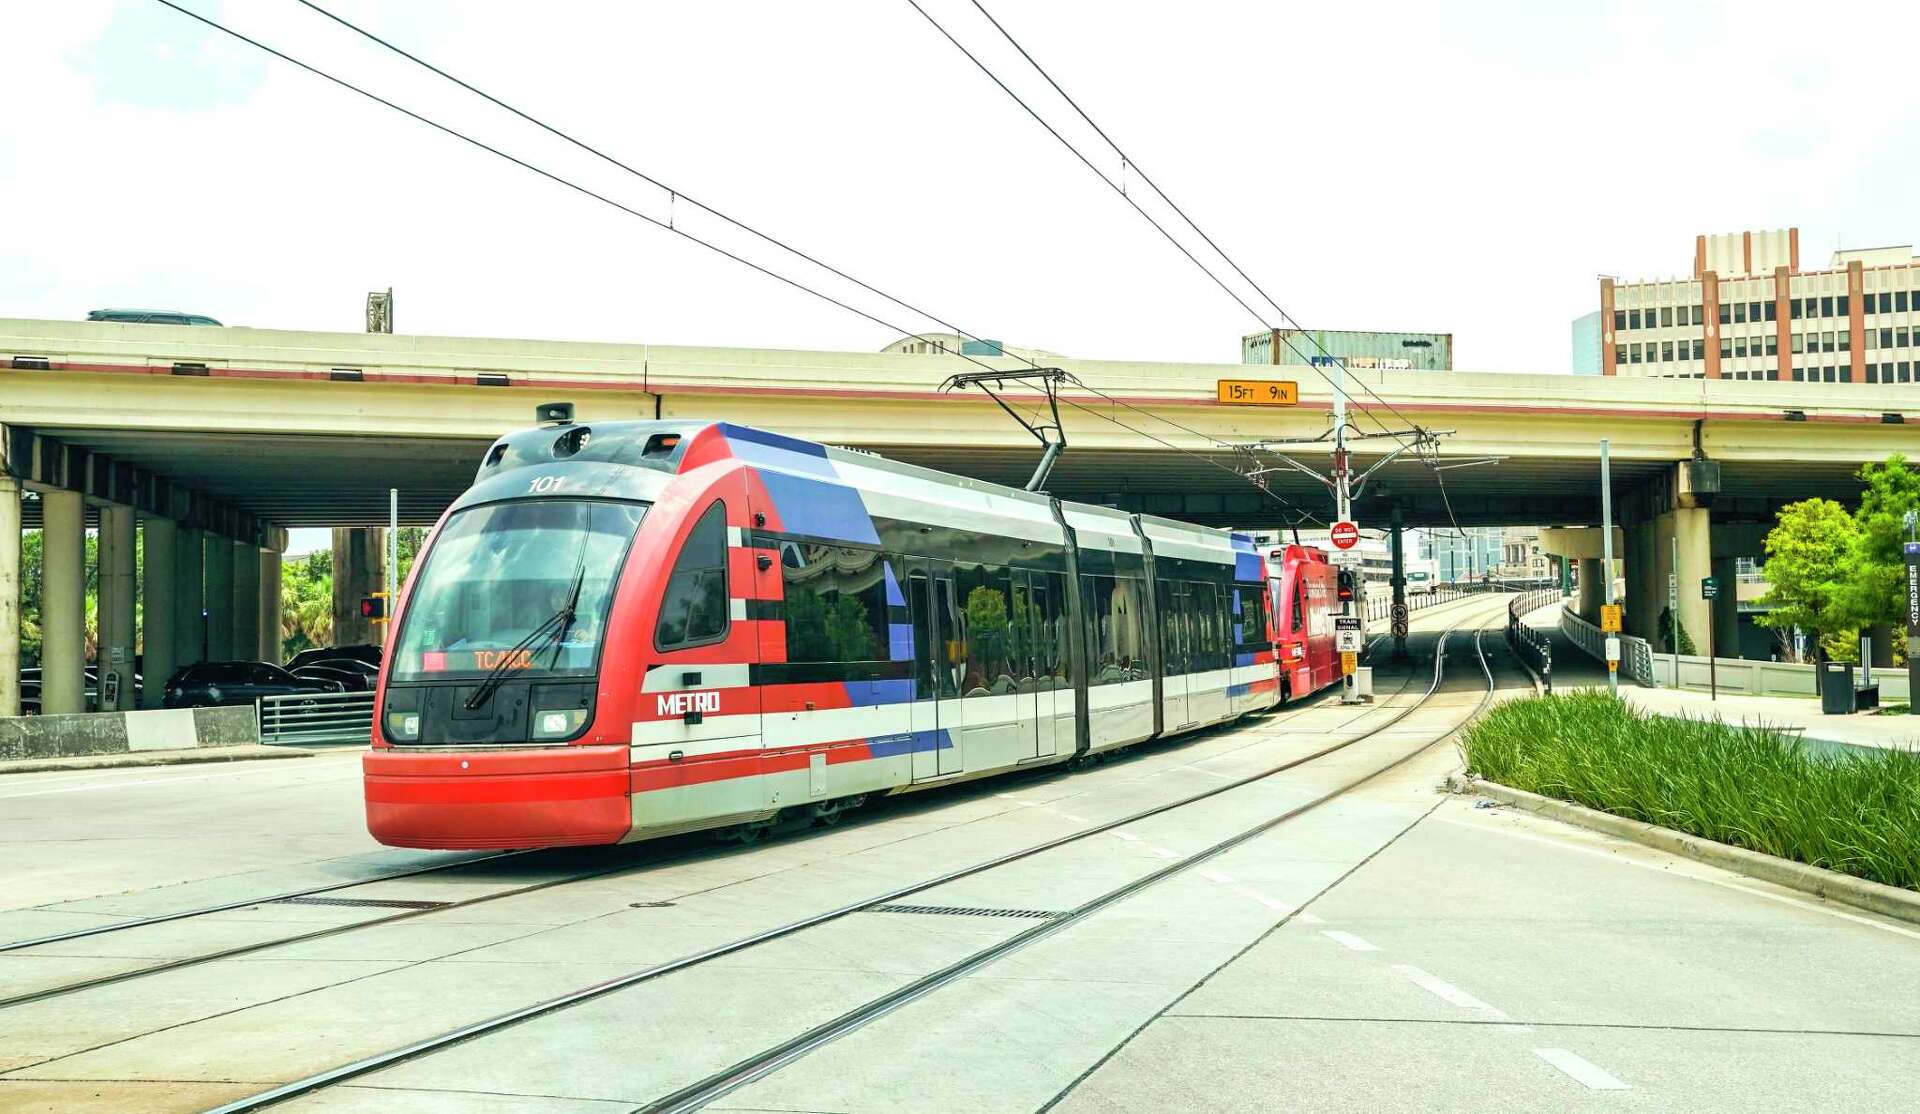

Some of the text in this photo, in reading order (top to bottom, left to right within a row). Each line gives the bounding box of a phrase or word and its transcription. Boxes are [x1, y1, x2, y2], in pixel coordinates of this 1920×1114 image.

[1229, 385, 1288, 400] 15FT 9IN
[528, 475, 566, 493] 101
[1909, 565, 1919, 626] EMERGENCY
[657, 692, 720, 716] METRO
